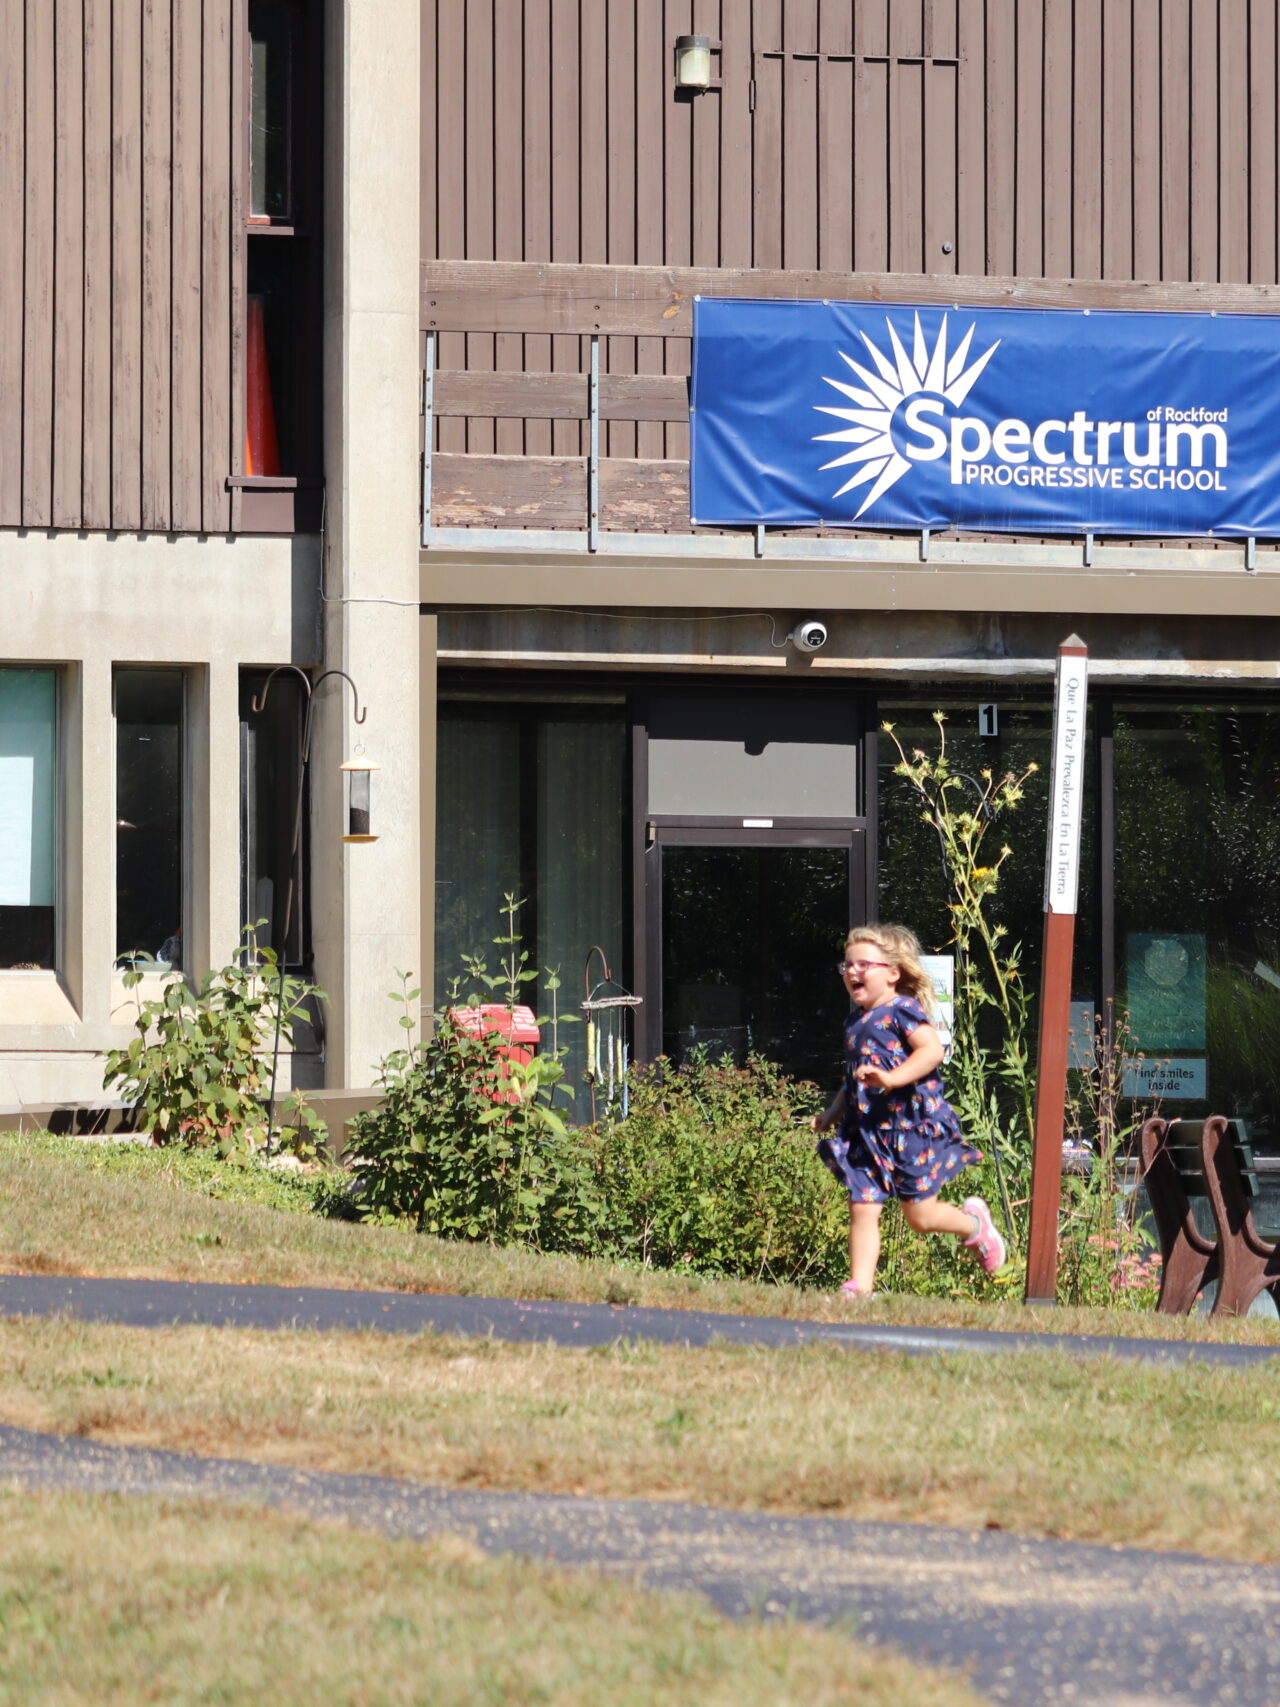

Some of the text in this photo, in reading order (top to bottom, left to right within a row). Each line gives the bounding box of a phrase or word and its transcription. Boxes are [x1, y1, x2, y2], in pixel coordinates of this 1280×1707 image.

[1146, 406, 1228, 423] of Rockford
[904, 398, 1228, 485] Spectrum
[966, 464, 1227, 491] PROGRESSIVE SCHOOL
[983, 705, 994, 735] 1
[1056, 677, 1080, 895] Que La Paz Prevalezca En La Tierra
[1148, 1079, 1180, 1090] inside
[1160, 1067, 1194, 1079] smiles
